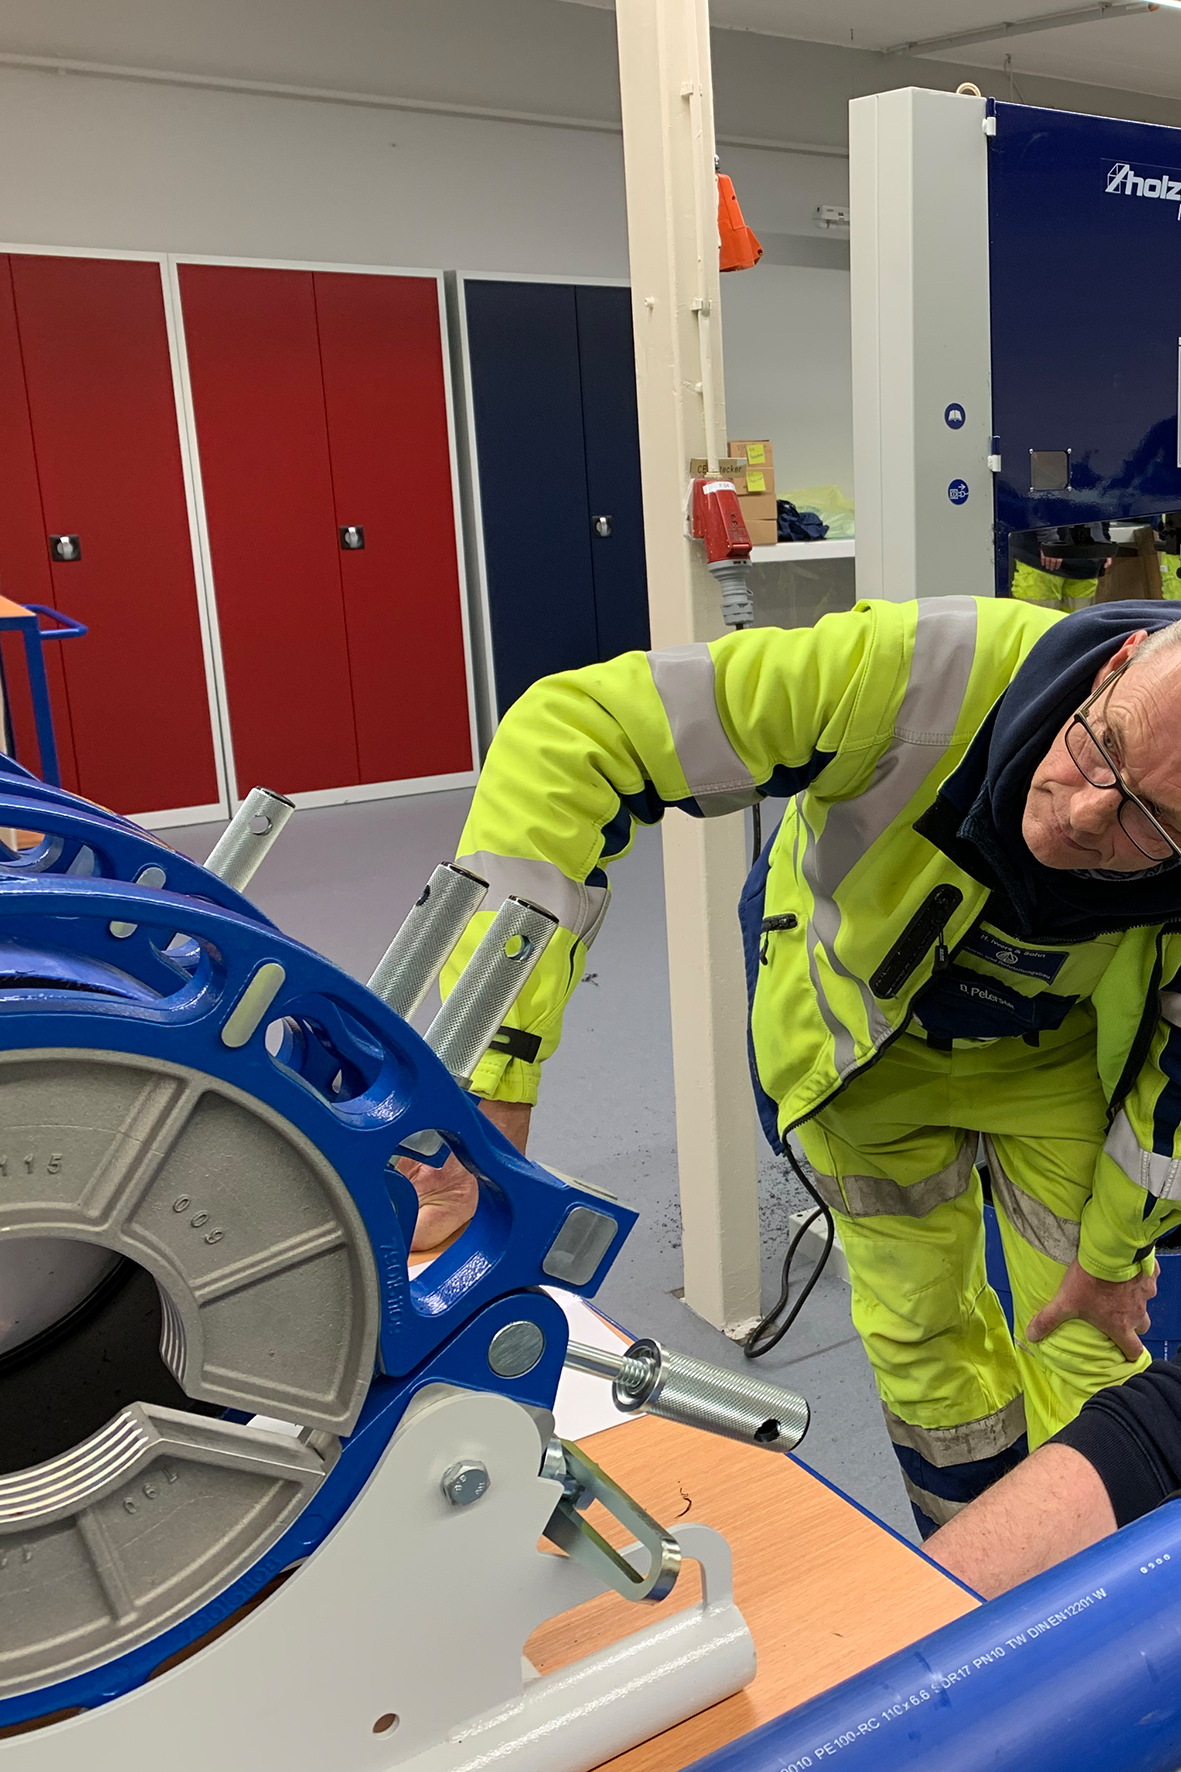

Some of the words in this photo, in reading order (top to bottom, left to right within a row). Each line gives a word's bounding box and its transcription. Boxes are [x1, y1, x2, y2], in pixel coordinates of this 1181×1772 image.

[814, 1717, 880, 1760] PE100-RC
[972, 1646, 1006, 1670] PN10
[1005, 1633, 1028, 1650] TW
